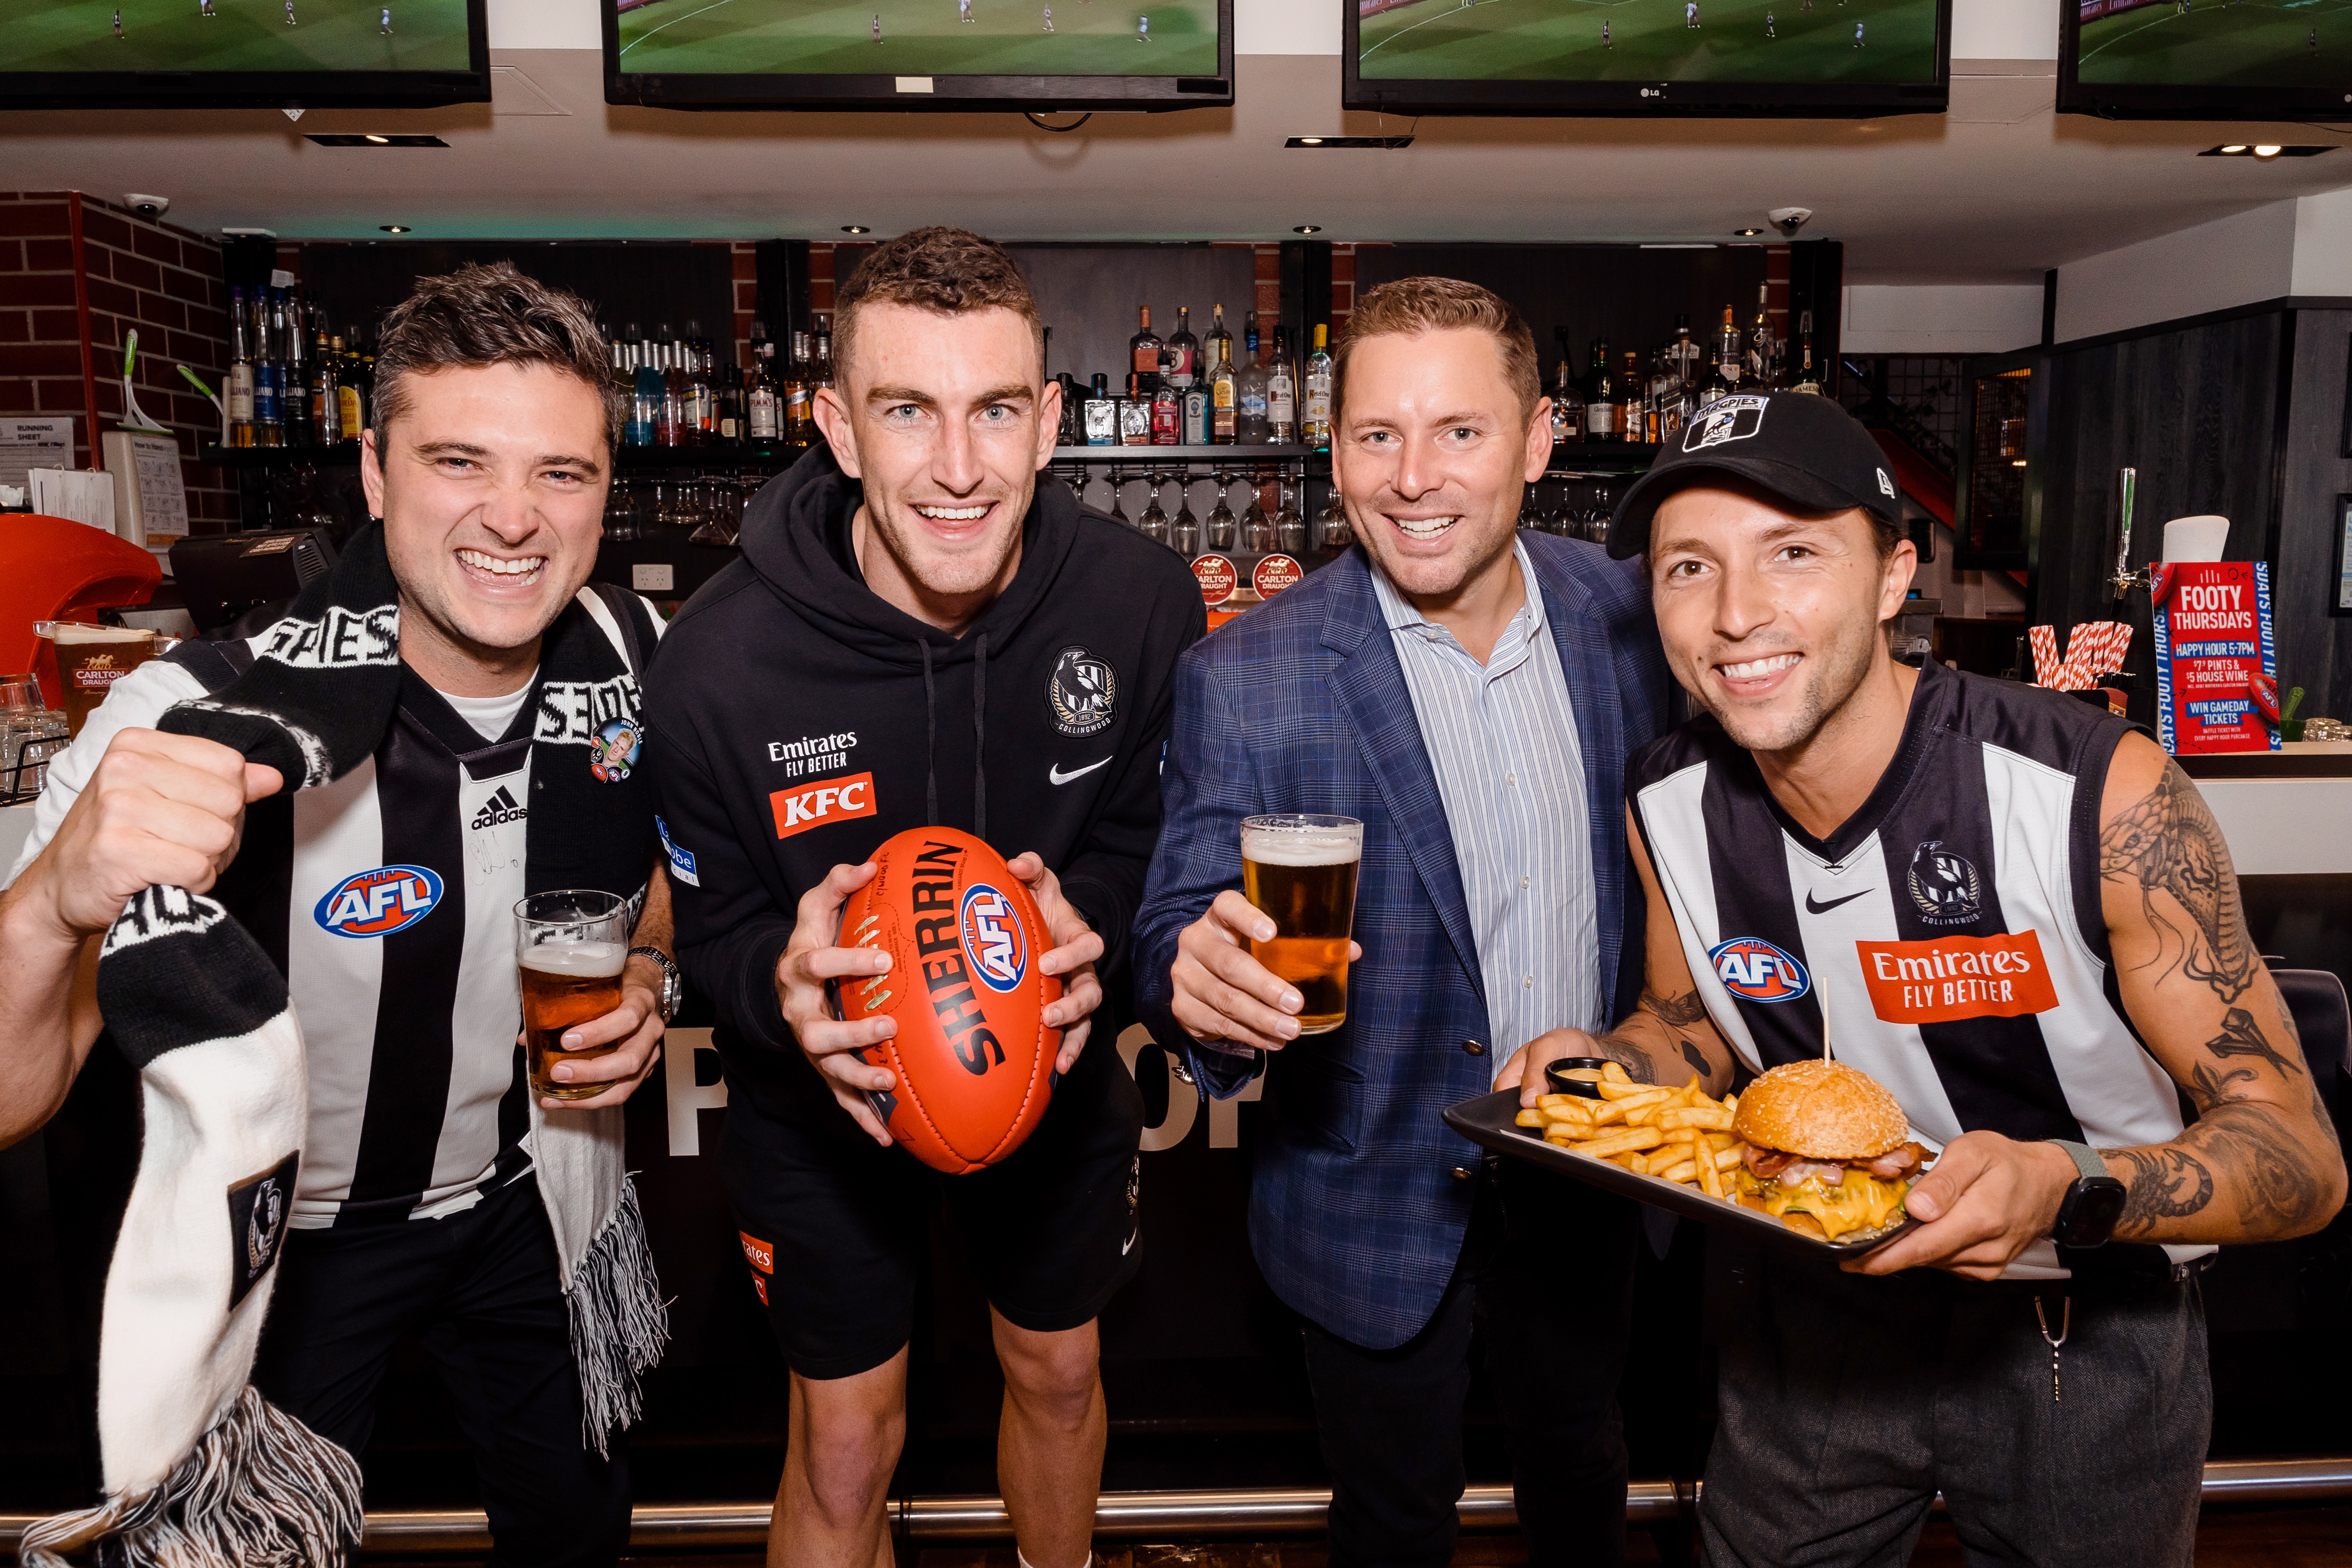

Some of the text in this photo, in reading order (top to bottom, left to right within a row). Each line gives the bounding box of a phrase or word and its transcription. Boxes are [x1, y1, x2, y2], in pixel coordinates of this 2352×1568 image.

[2080, 2, 2102, 17] mirates
[750, 397, 773, 407] PIMM'S
[1697, 398, 1759, 420] MAGPIES
[1196, 575, 1232, 583] ARLTON
[1257, 575, 1299, 583] CARLTON
[2152, 574, 2163, 592] AFL
[2180, 585, 2242, 611] FOOTY
[2174, 611, 2252, 630] THURSDAYS
[2176, 642, 2255, 657] HAPPY HOUR 5-7PM
[2208, 659, 2233, 671] PINTS
[2233, 659, 2240, 670] &
[76, 671, 125, 679] CARLTON
[2186, 670, 2249, 682] $5 HOUSE WINE
[2190, 700, 2249, 713] WIN GAMEDAY
[2263, 691, 2276, 707] AFL
[1058, 717, 1111, 734] COLLINGWOOD
[2204, 713, 2239, 725] TICKETS
[620, 719, 643, 745] JOHN NOBLE
[768, 731, 858, 762] Emirates
[786, 751, 847, 777] FLY BETTER
[609, 769, 620, 782] AFL
[784, 781, 866, 828] KFC
[471, 808, 527, 831] adidas
[326, 877, 433, 927] AFL
[1922, 913, 1980, 925] COLLINGWOOD
[973, 893, 1018, 982] AFL
[912, 840, 1007, 1077] SHERRIN
[1871, 949, 2031, 981] Emirates
[1720, 951, 1803, 990] AFL
[1904, 979, 2014, 1008] FLY BETTER
